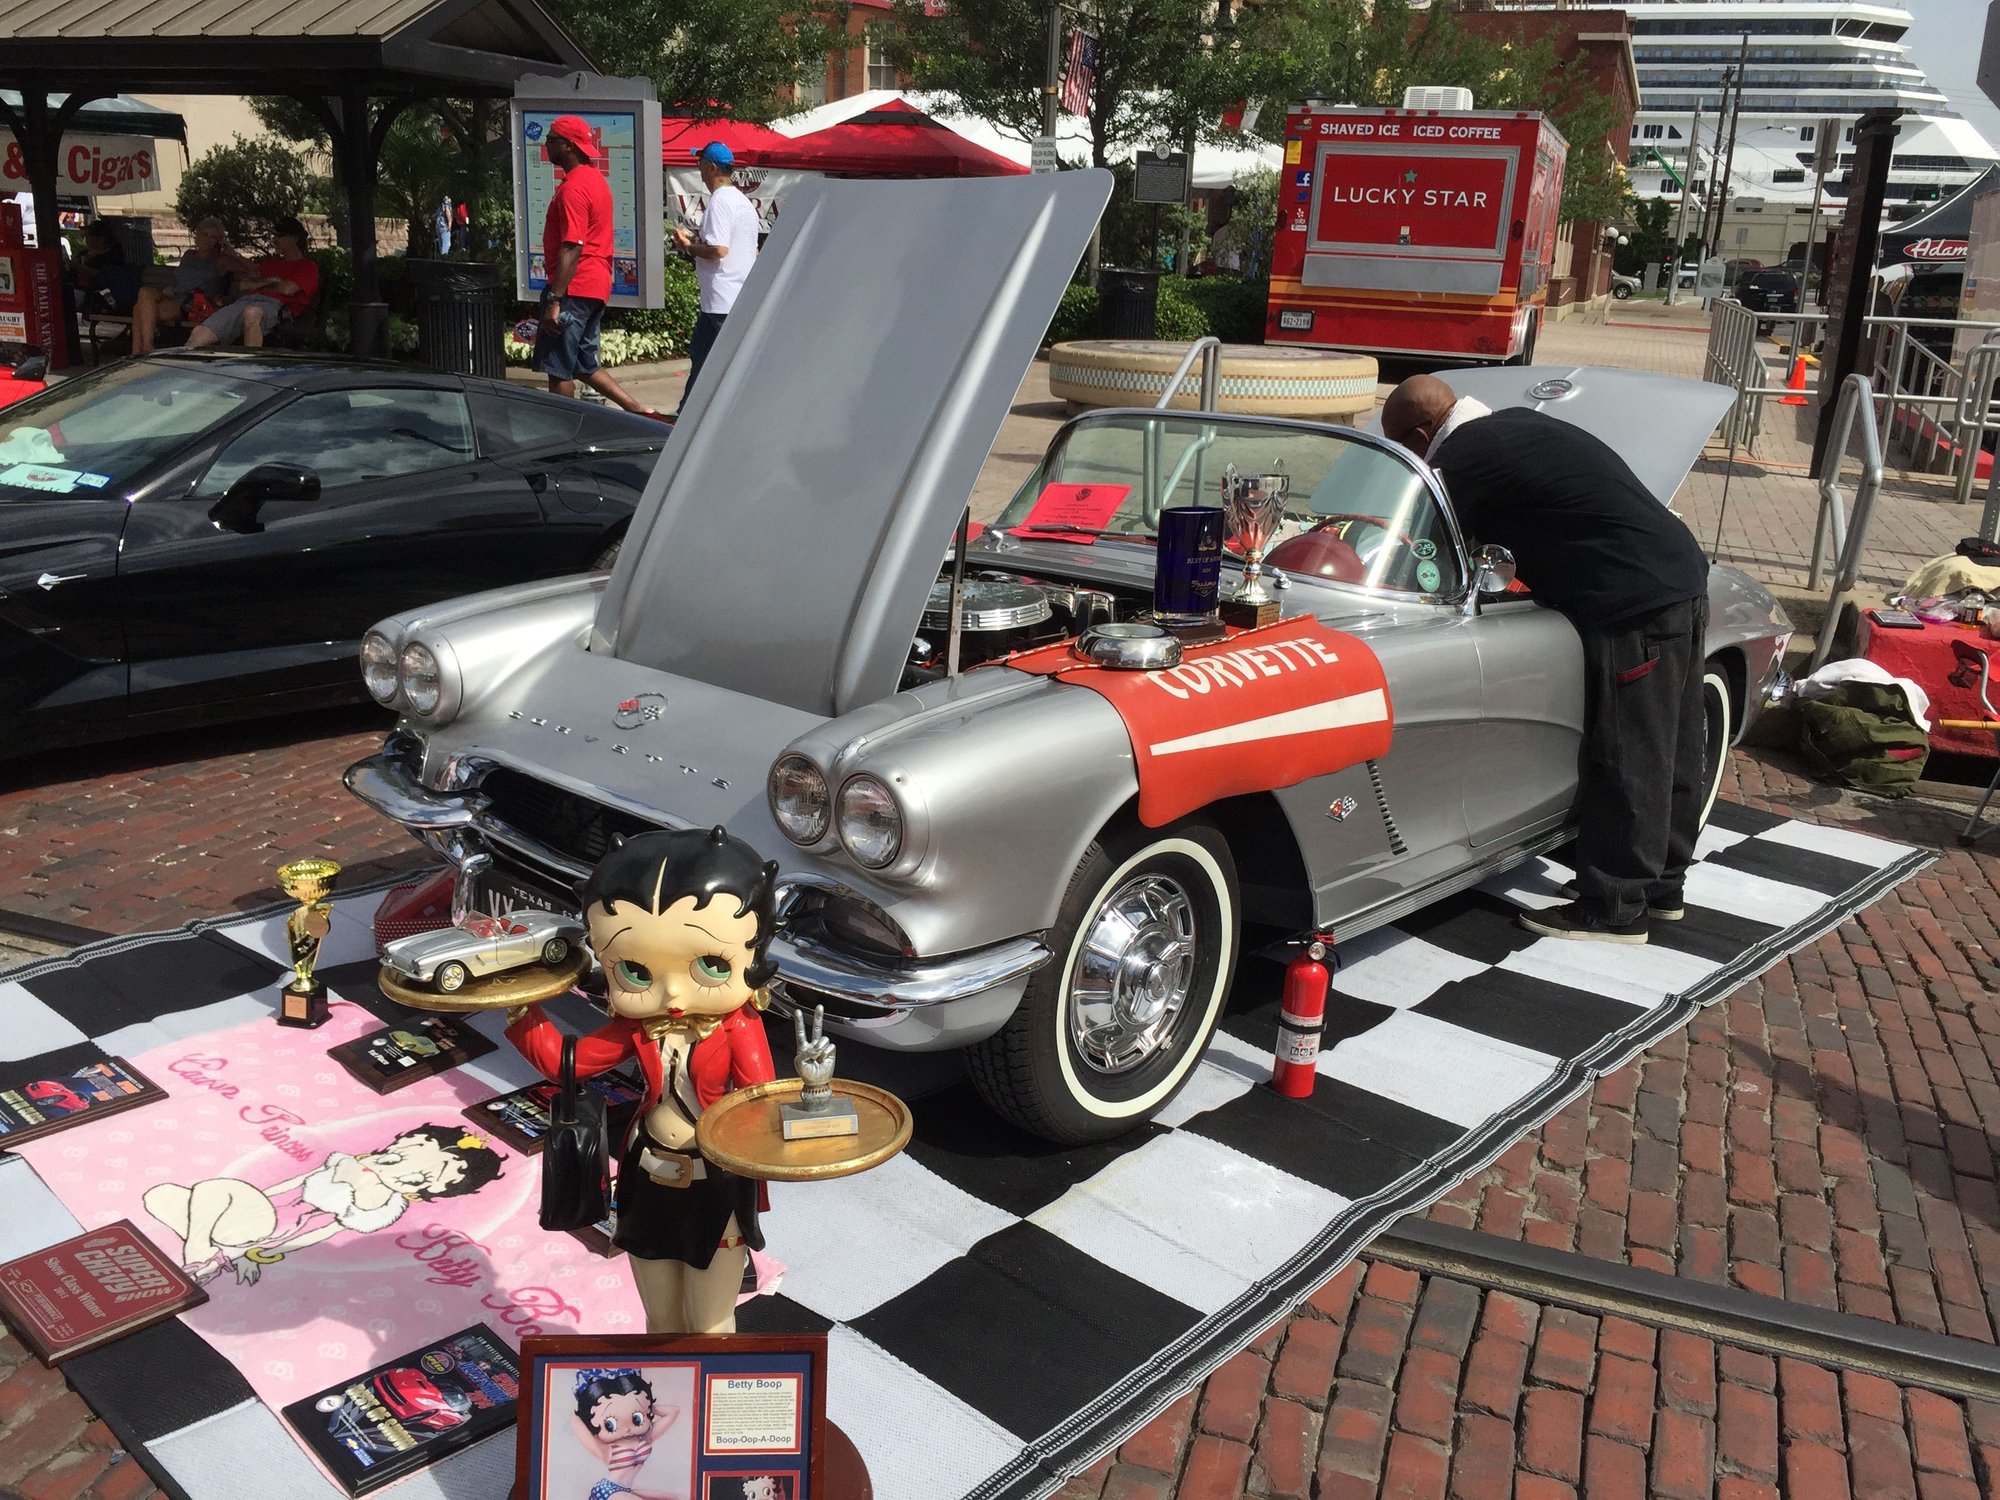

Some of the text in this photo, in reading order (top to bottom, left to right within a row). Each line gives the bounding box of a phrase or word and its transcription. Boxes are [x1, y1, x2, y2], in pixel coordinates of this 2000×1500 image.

[1320, 123, 1502, 139] SHAVED ICE ICED COFFEE
[68, 145, 151, 190] Cigars
[1334, 186, 1488, 208] LUCKY STAR
[1911, 238, 1968, 258] Adam
[36, 262, 48, 284] THE
[38, 285, 50, 319] DAILY
[1146, 637, 1339, 699] CORVETTE
[511, 886, 552, 911] TEXAS
[239, 1105, 313, 1162] Princess
[74, 1250, 139, 1293] CHEVY
[105, 1244, 170, 1288] SUPER
[395, 1223, 493, 1287] Betty
[43, 1257, 65, 1277] Show
[60, 1274, 83, 1295] Class
[79, 1291, 107, 1319] Winner
[481, 1286, 581, 1337] Bo
[728, 1379, 782, 1390] Betty Boop
[716, 1435, 791, 1445] Boop-Oop-A-Doop
